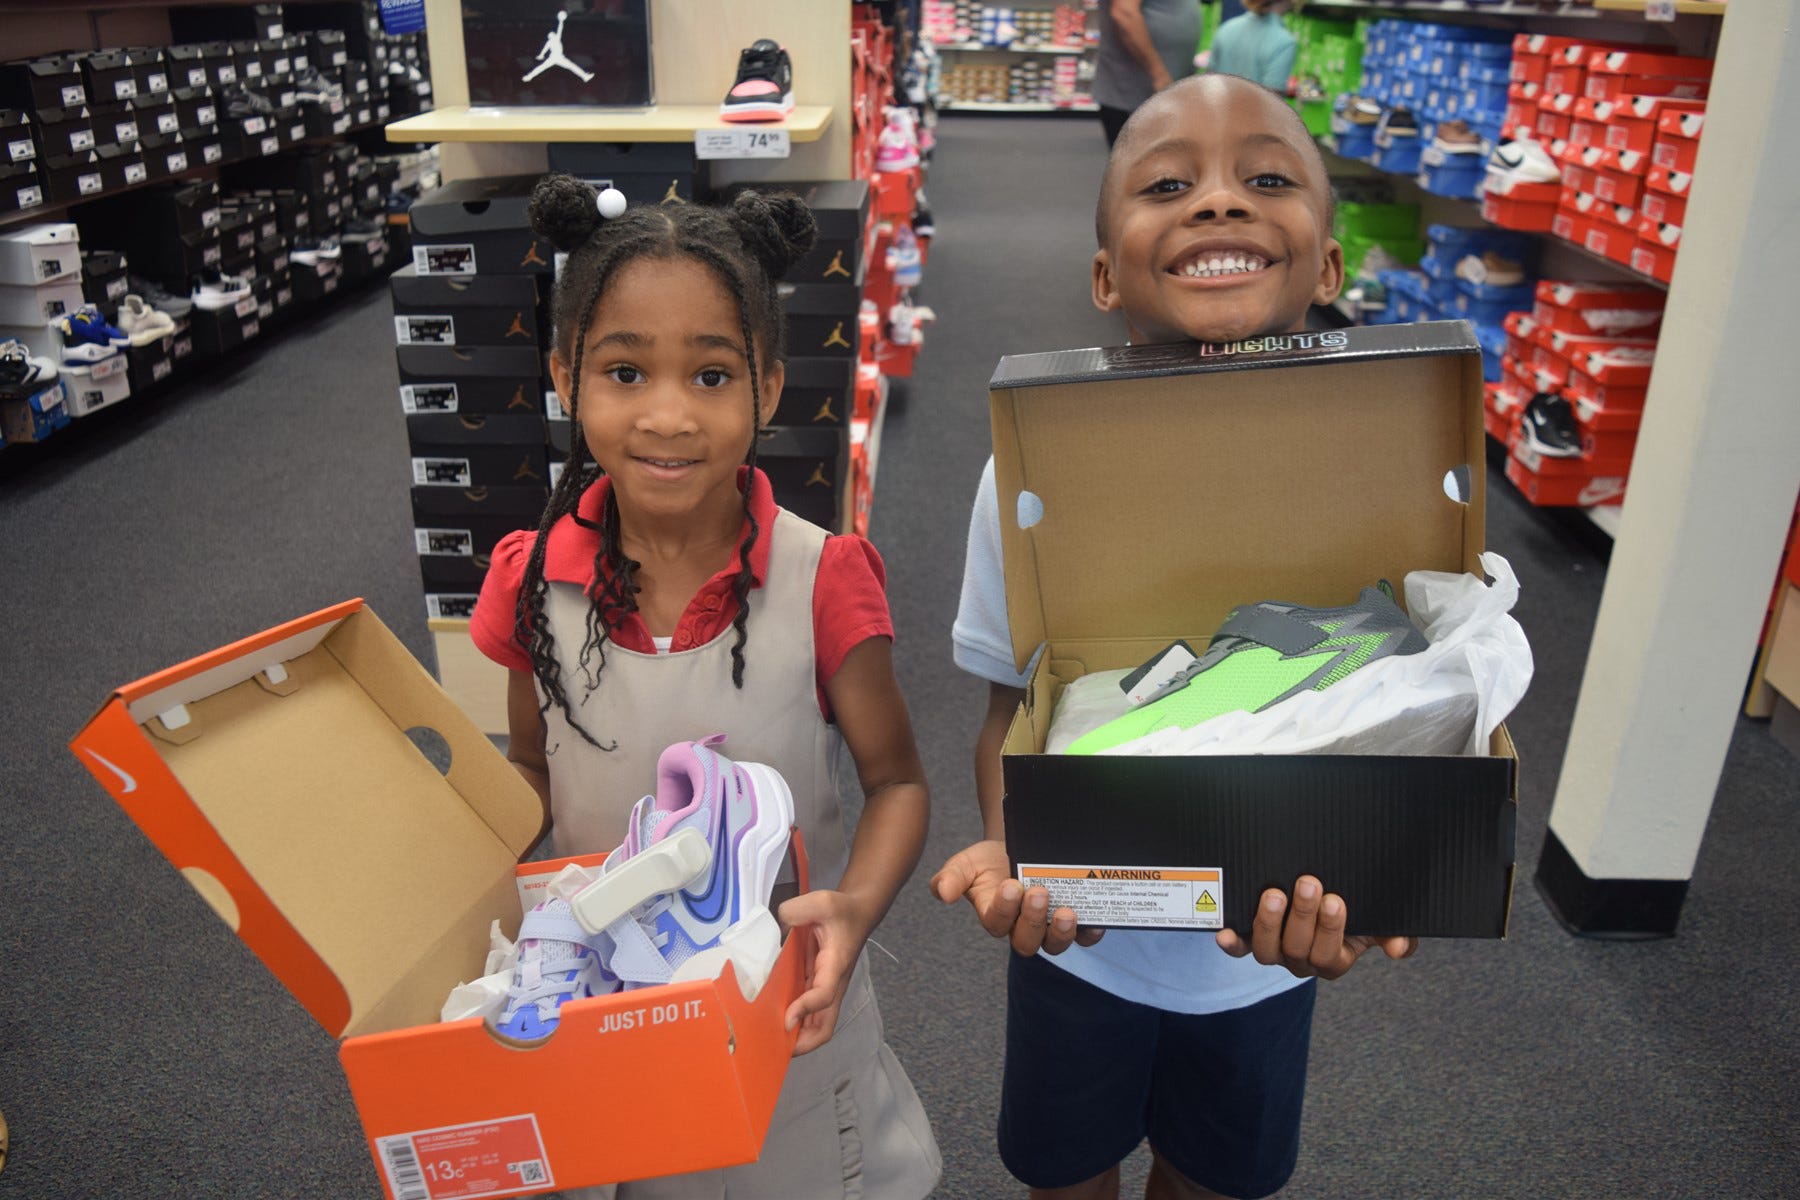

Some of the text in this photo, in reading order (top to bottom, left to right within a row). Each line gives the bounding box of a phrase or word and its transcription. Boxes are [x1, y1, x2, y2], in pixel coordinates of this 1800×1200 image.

[1200, 331, 1348, 357] LIGHTS
[1101, 870, 1161, 880] WARNING
[598, 999, 706, 1033] JUST DO IT.
